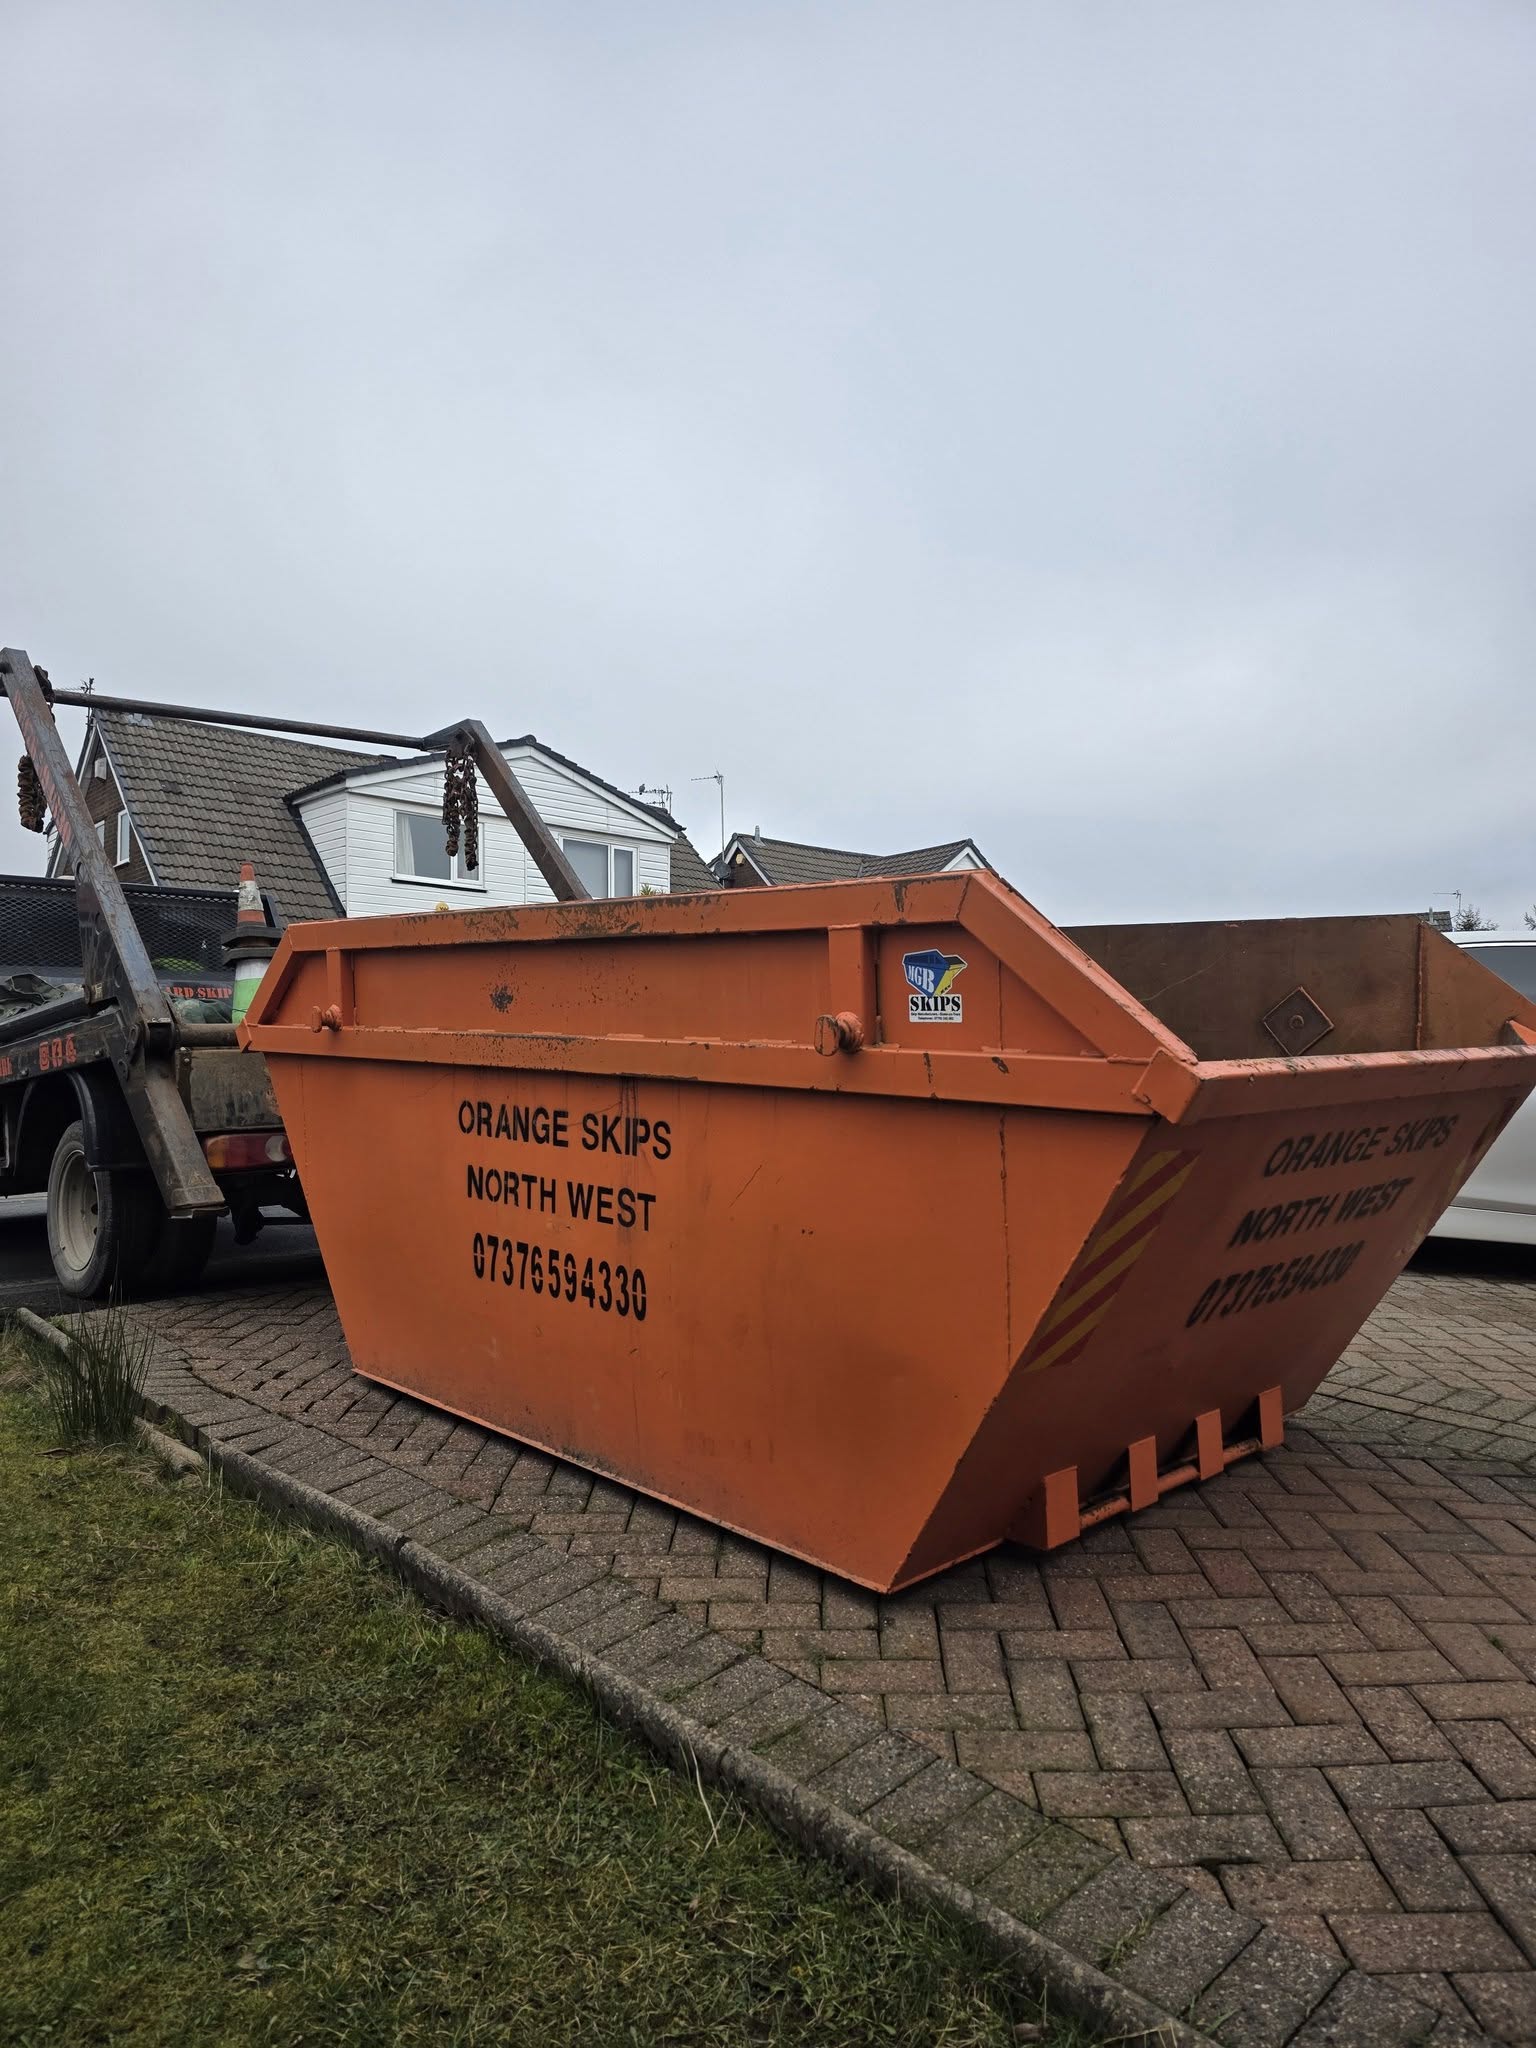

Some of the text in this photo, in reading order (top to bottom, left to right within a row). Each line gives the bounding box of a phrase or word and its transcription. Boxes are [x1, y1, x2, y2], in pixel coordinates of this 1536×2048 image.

[907, 964, 935, 993] MGB
[910, 996, 961, 1012] SKIPS
[458, 1100, 672, 1160] ORANGE SKIPS
[1263, 1113, 1460, 1178] ORANGE SKIPS
[467, 1164, 657, 1232] NORTH WEST
[1227, 1176, 1415, 1250] NORTH WEST
[472, 1232, 647, 1322] 07376594330
[1184, 1239, 1366, 1329] 07376594330
